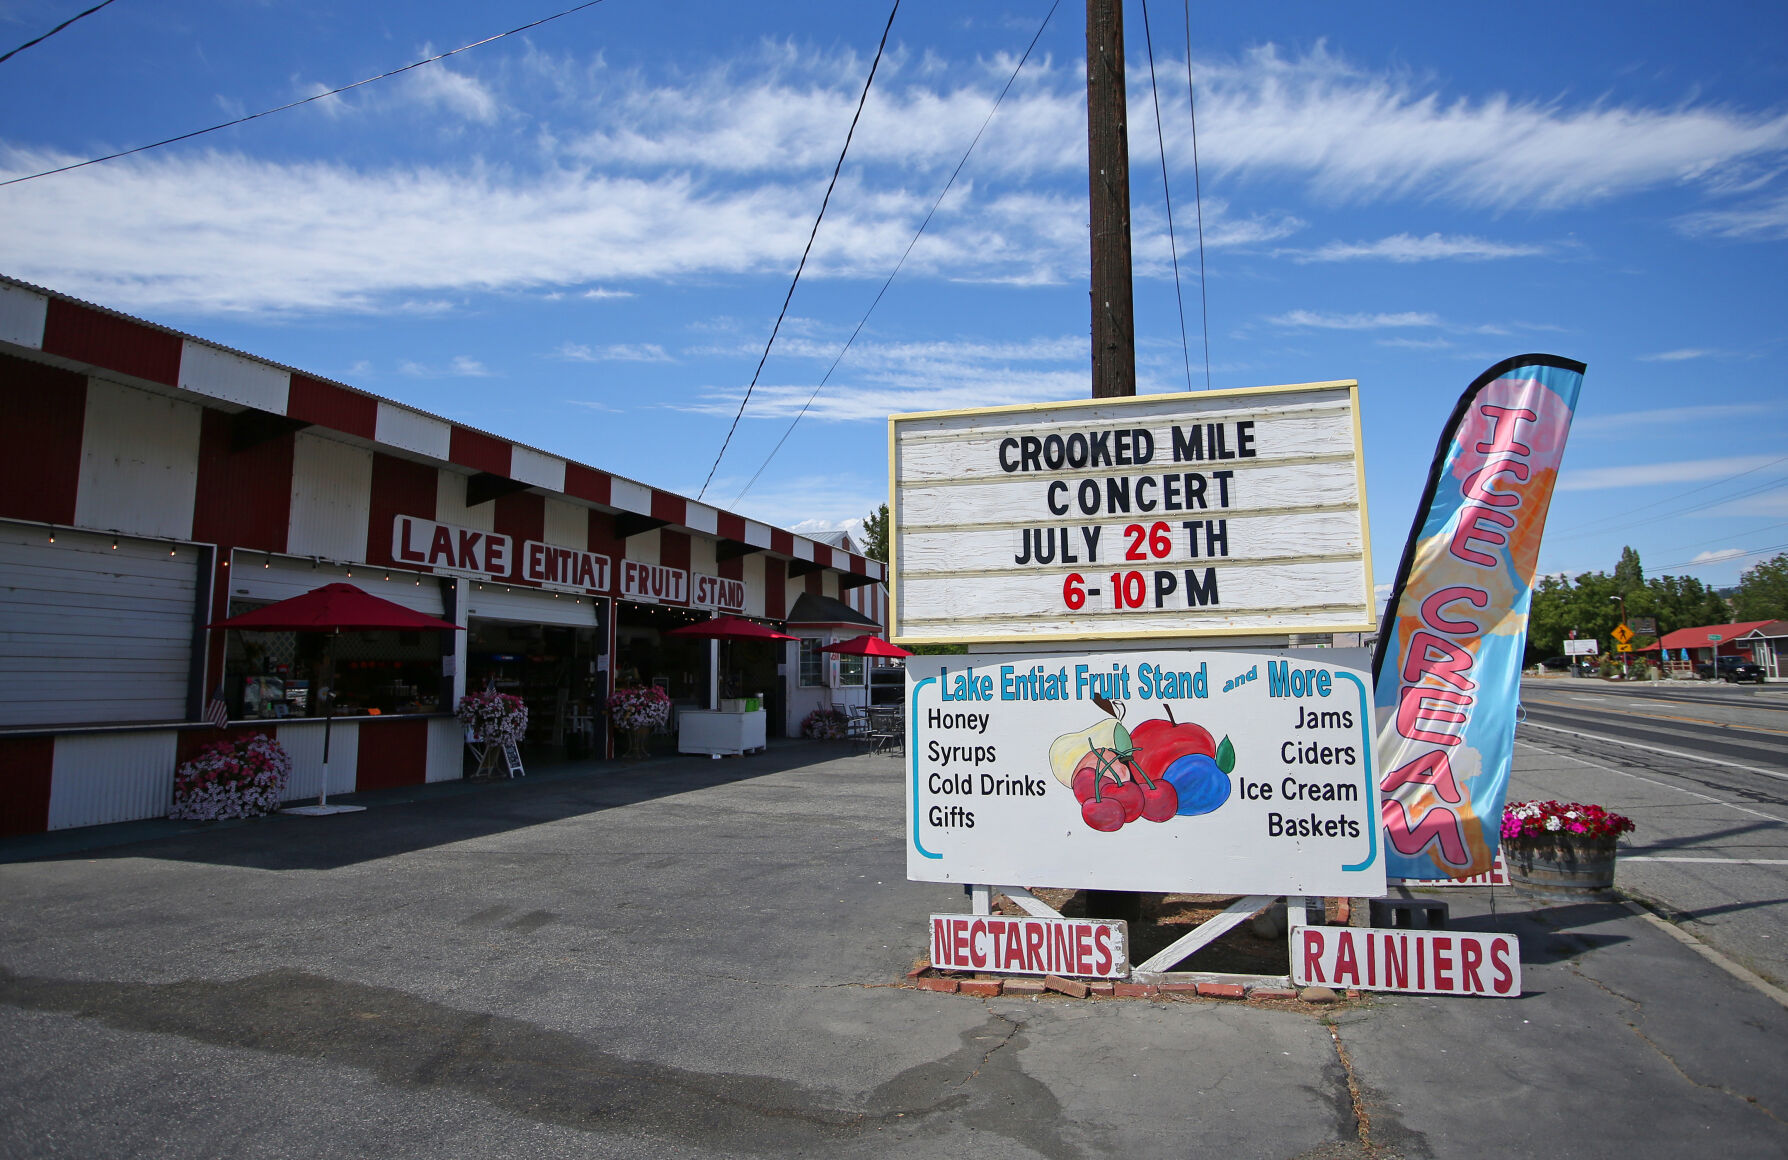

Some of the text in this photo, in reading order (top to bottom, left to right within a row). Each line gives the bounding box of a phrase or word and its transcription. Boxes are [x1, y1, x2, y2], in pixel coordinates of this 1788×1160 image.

[999, 421, 1256, 472] CROOKED MILE
[1048, 471, 1233, 515] CONCERT
[1449, 405, 1538, 567] ICE
[400, 519, 745, 608] LAKE ENTIAT FRUIT STAND
[1015, 526, 1101, 564] JULY
[942, 661, 1331, 701] Lake Entiat Fruit Stand and More
[929, 709, 989, 734] Honey
[1295, 707, 1353, 729] Jams
[1381, 586, 1489, 866] CREAM
[928, 741, 995, 766] Syrups
[1282, 742, 1355, 765] Ciders
[929, 773, 1046, 796] Cold Drinks
[1240, 778, 1357, 801] Ice Cream
[929, 806, 974, 828] Gifts
[1269, 813, 1360, 837] Baskets
[934, 919, 1113, 977] NECTARINES
[1305, 931, 1511, 993] RAINIERS
